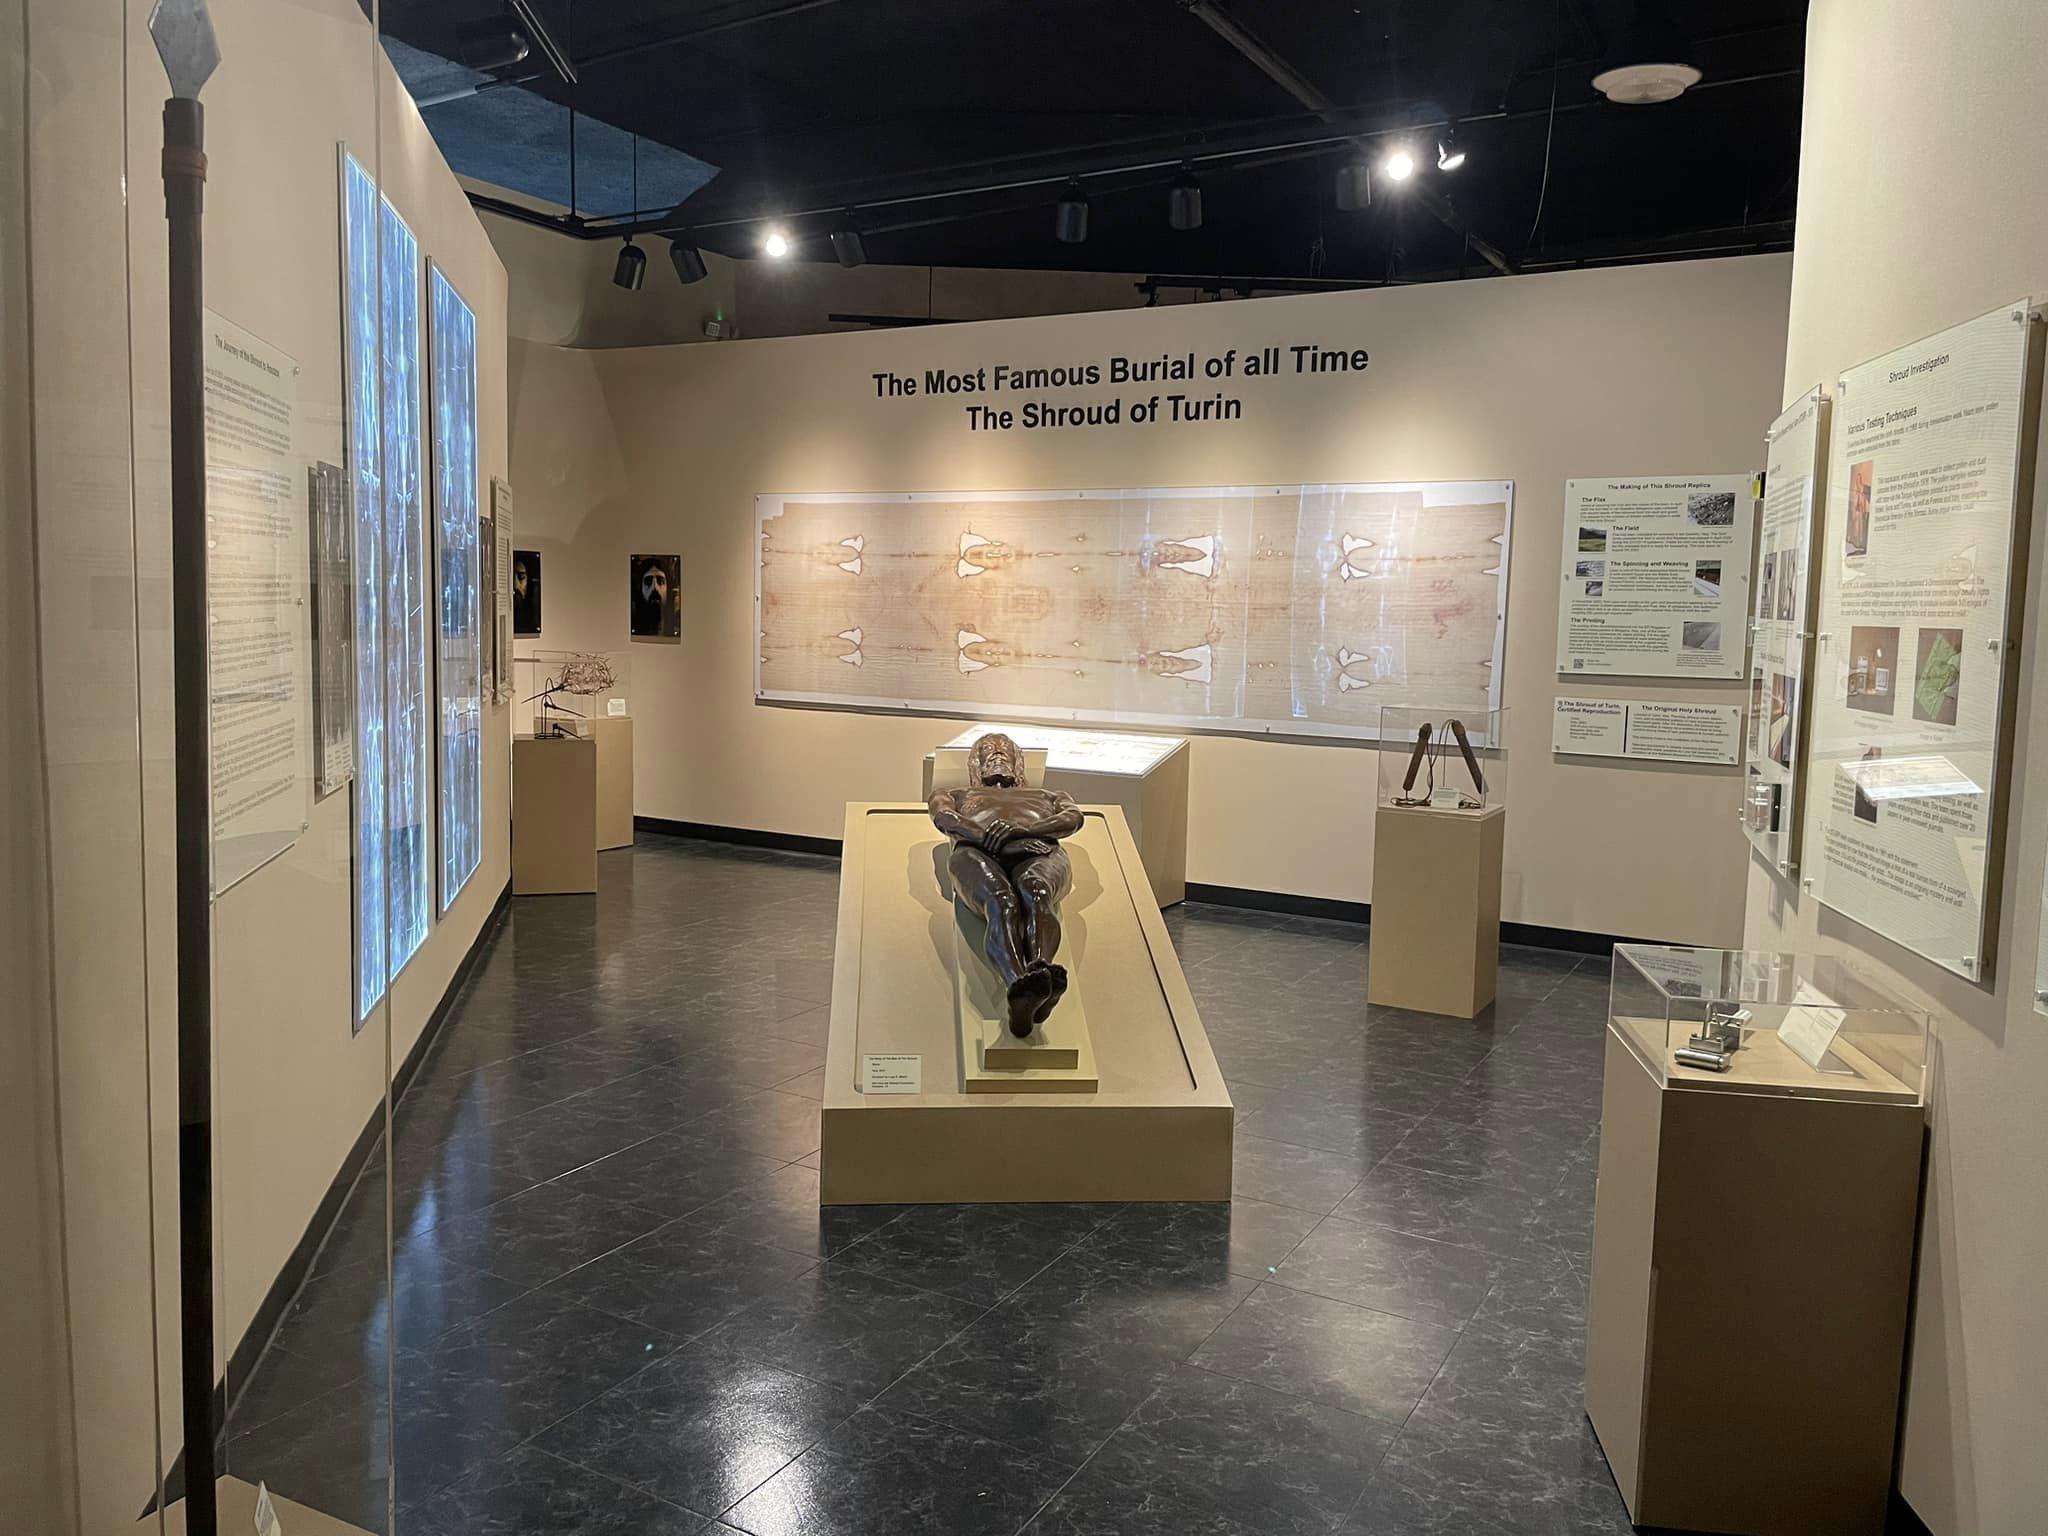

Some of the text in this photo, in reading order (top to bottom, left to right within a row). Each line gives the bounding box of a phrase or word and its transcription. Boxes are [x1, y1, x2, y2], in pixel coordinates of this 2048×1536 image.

[872, 345, 1369, 397] The Most Famous Burial of all Time
[1888, 354, 1950, 383] Shroud Investigation
[966, 393, 1241, 431] The Shroud of Turin
[1847, 423, 1866, 435] Various
[1885, 406, 1917, 424] Techniques
